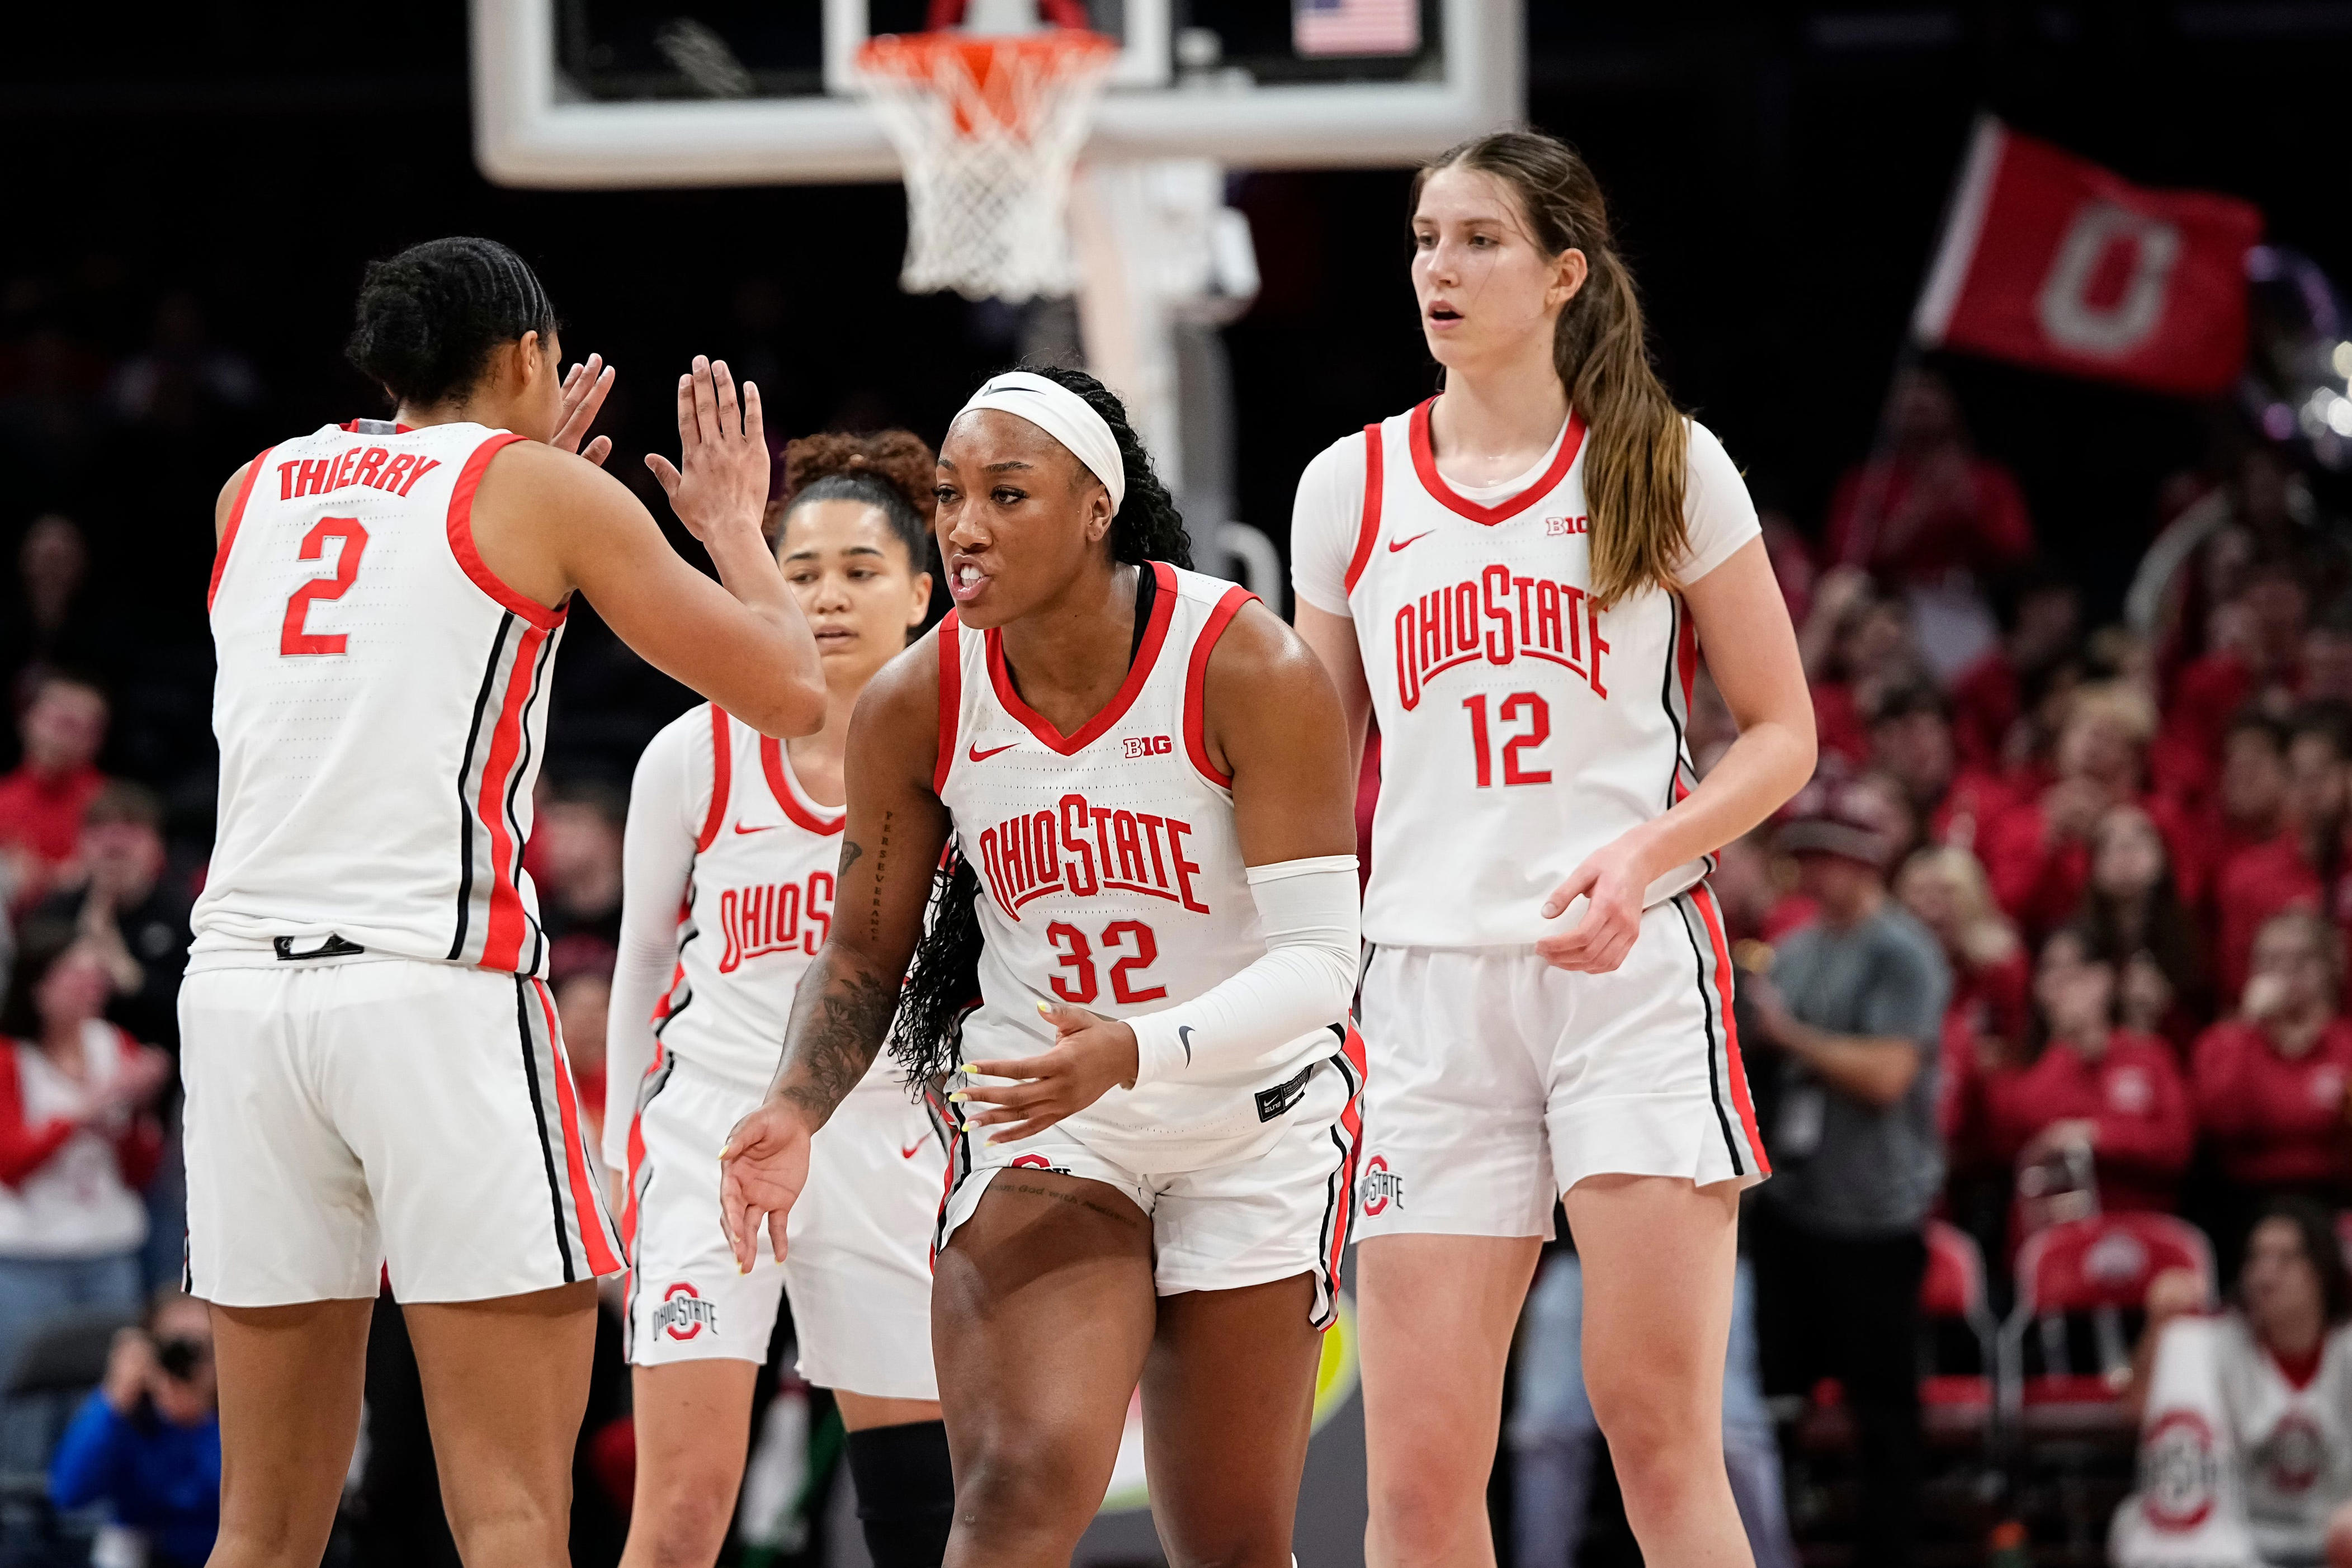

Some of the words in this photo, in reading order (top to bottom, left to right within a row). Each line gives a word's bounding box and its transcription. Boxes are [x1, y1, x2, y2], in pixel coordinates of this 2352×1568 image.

[277, 447, 441, 500] THIERRY
[280, 516, 369, 658] 2
[1462, 691, 1552, 788] 12
[871, 811, 893, 942] PERSEVERANCE
[1046, 919, 1169, 1005] 32
